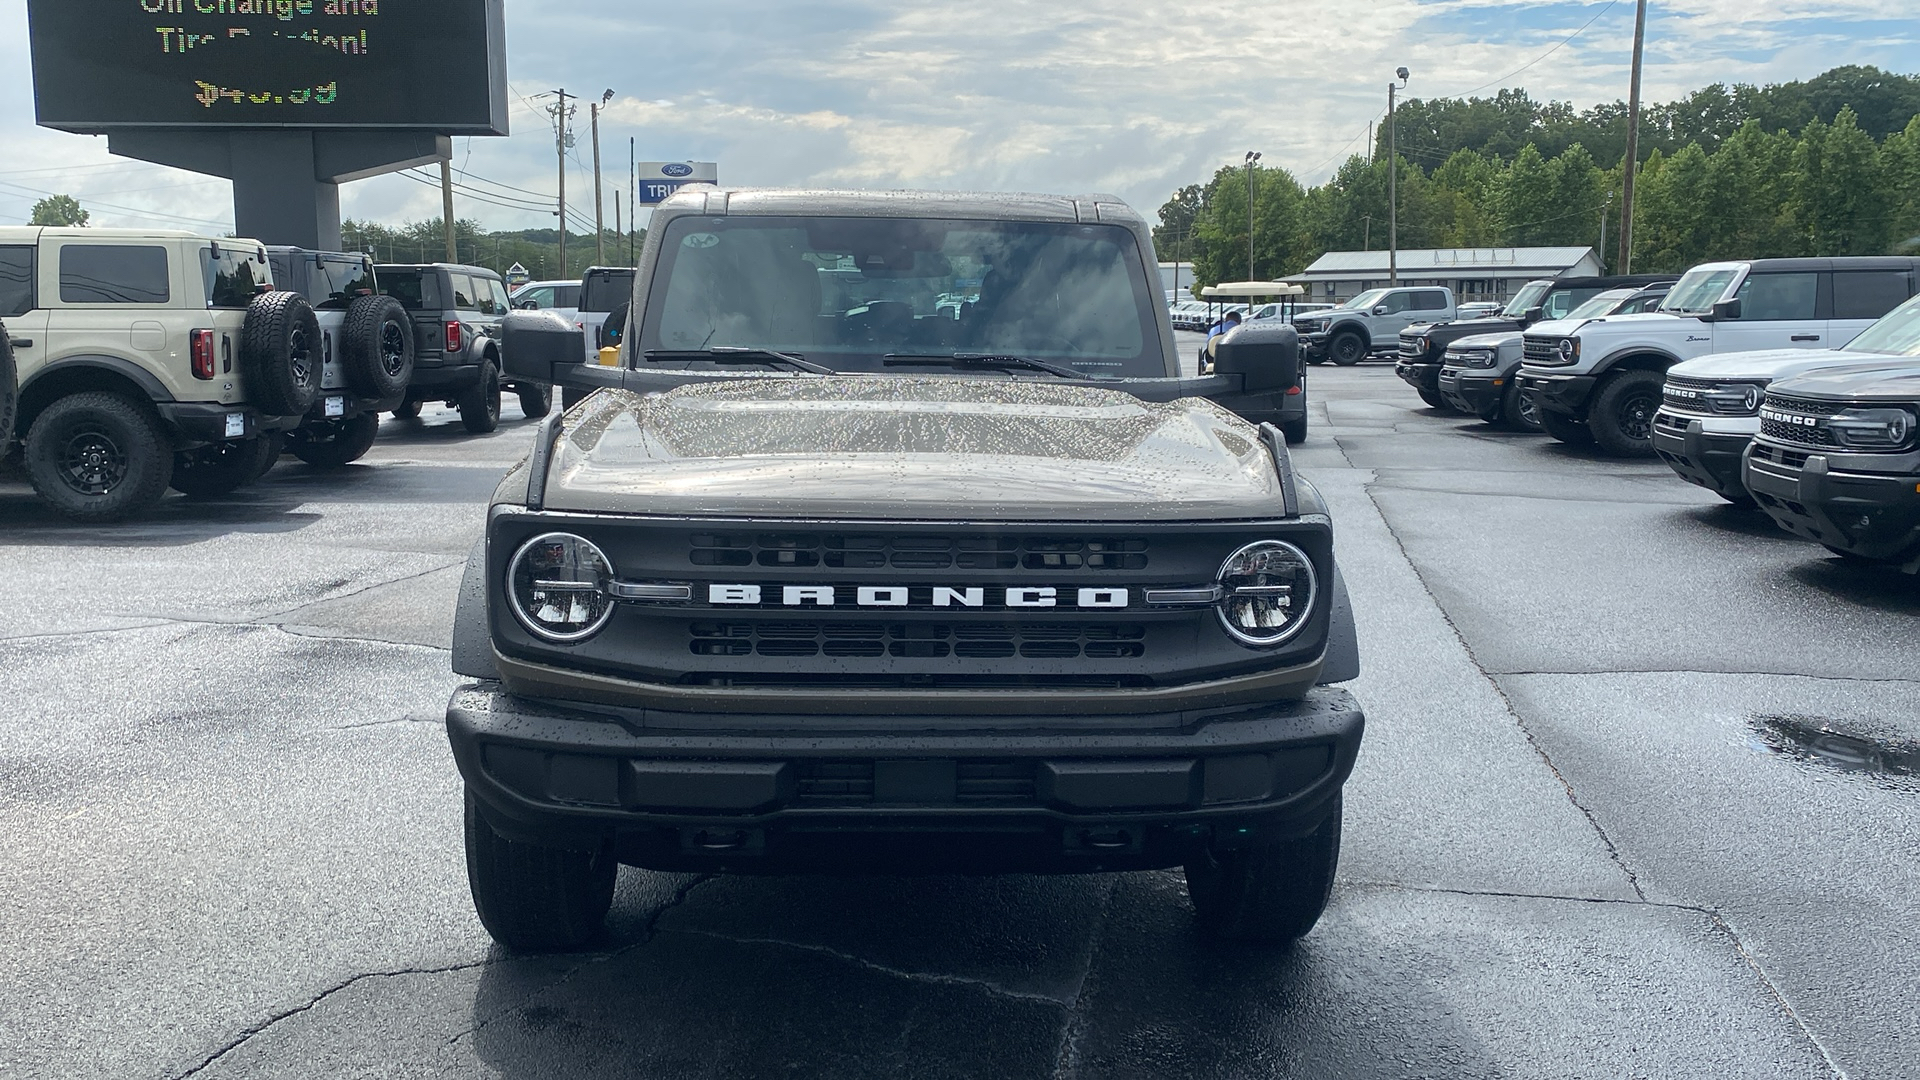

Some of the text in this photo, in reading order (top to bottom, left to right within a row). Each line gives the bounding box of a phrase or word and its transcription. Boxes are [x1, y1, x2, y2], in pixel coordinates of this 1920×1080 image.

[194, 0, 313, 21] Change
[324, 0, 379, 15] and
[1663, 387, 1696, 399] BRONCO
[1761, 410, 1816, 427] BRONCO
[708, 583, 1129, 608] BRONCO
